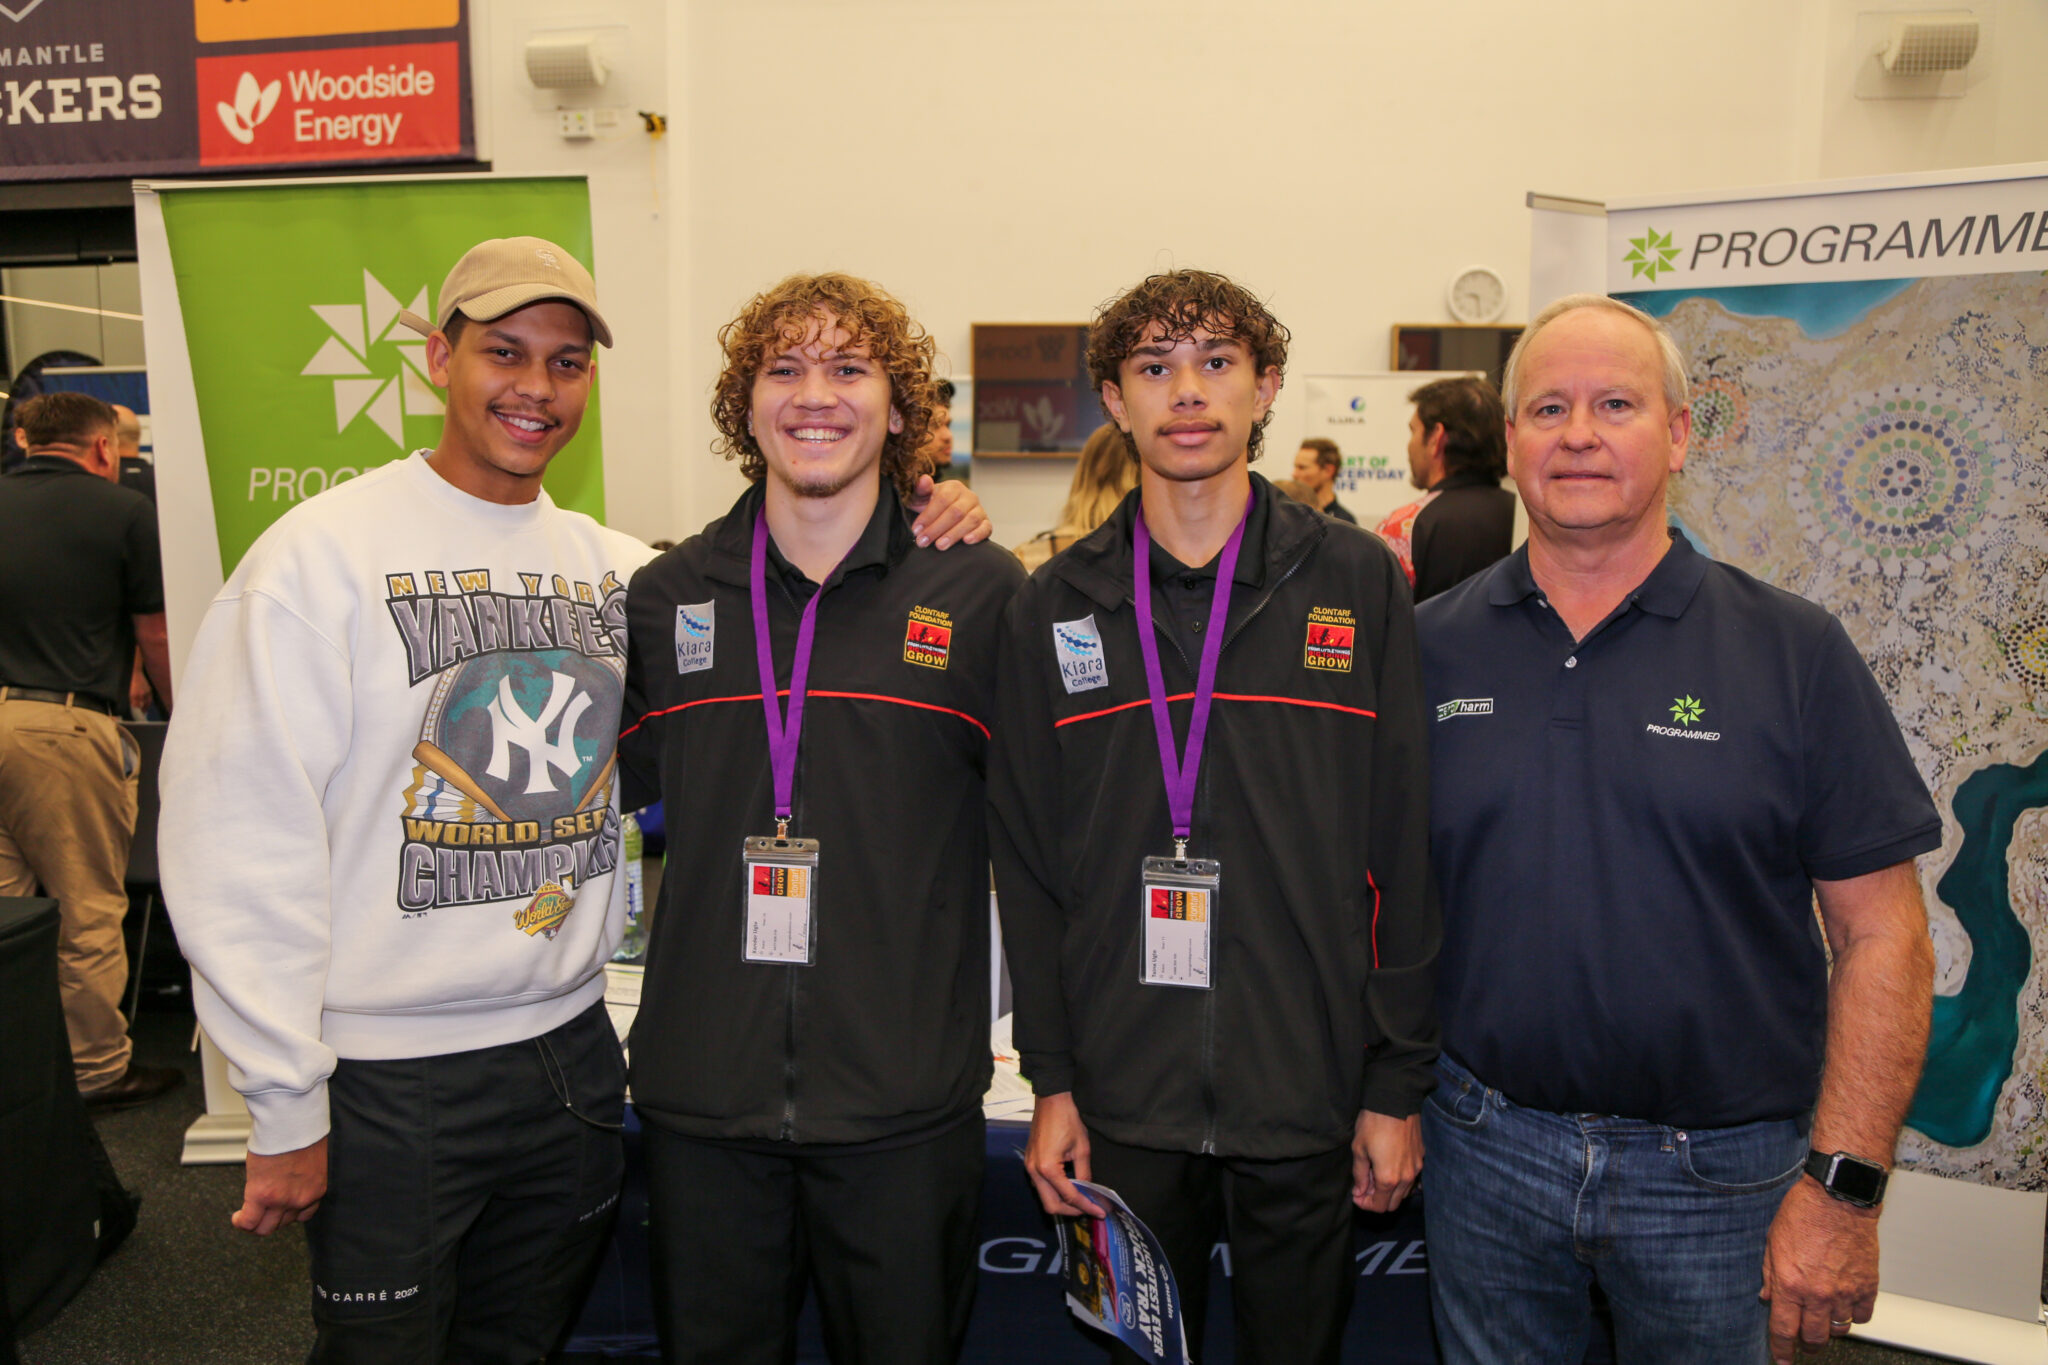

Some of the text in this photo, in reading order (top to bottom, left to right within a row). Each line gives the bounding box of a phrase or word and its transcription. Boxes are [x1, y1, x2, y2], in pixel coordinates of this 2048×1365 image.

[287, 62, 436, 103] Woodside
[0, 74, 162, 125] KERS
[294, 108, 403, 147] Energy
[1340, 456, 1388, 468] RT OF
[248, 466, 379, 502] PRO
[386, 568, 626, 604] NEW YORK
[908, 610, 953, 628] FOUNDATION
[914, 605, 950, 619] CLONTARF
[1308, 613, 1356, 625] FOUNDATION
[1313, 606, 1352, 617] CLONTARF
[386, 590, 629, 688] YANKEES
[677, 640, 712, 658] Kiara
[683, 656, 708, 667] College
[906, 650, 946, 667] GROW
[1062, 658, 1104, 679] Kiara
[1307, 655, 1350, 669] GROW
[1072, 675, 1102, 687] College
[1460, 701, 1491, 713] harm
[1646, 724, 1721, 741] PROGRAMMED
[402, 815, 541, 846] WORLD
[777, 868, 785, 896] GROW
[512, 901, 556, 930] World
[1175, 891, 1184, 919] GROW
[332, 1289, 388, 1302] CARRÉ
[394, 1284, 420, 1300] 202X
[1140, 1241, 1164, 1358] LIGHTEST EVER
[1163, 1281, 1174, 1319] austin
[1136, 1281, 1153, 1342] TRAY
